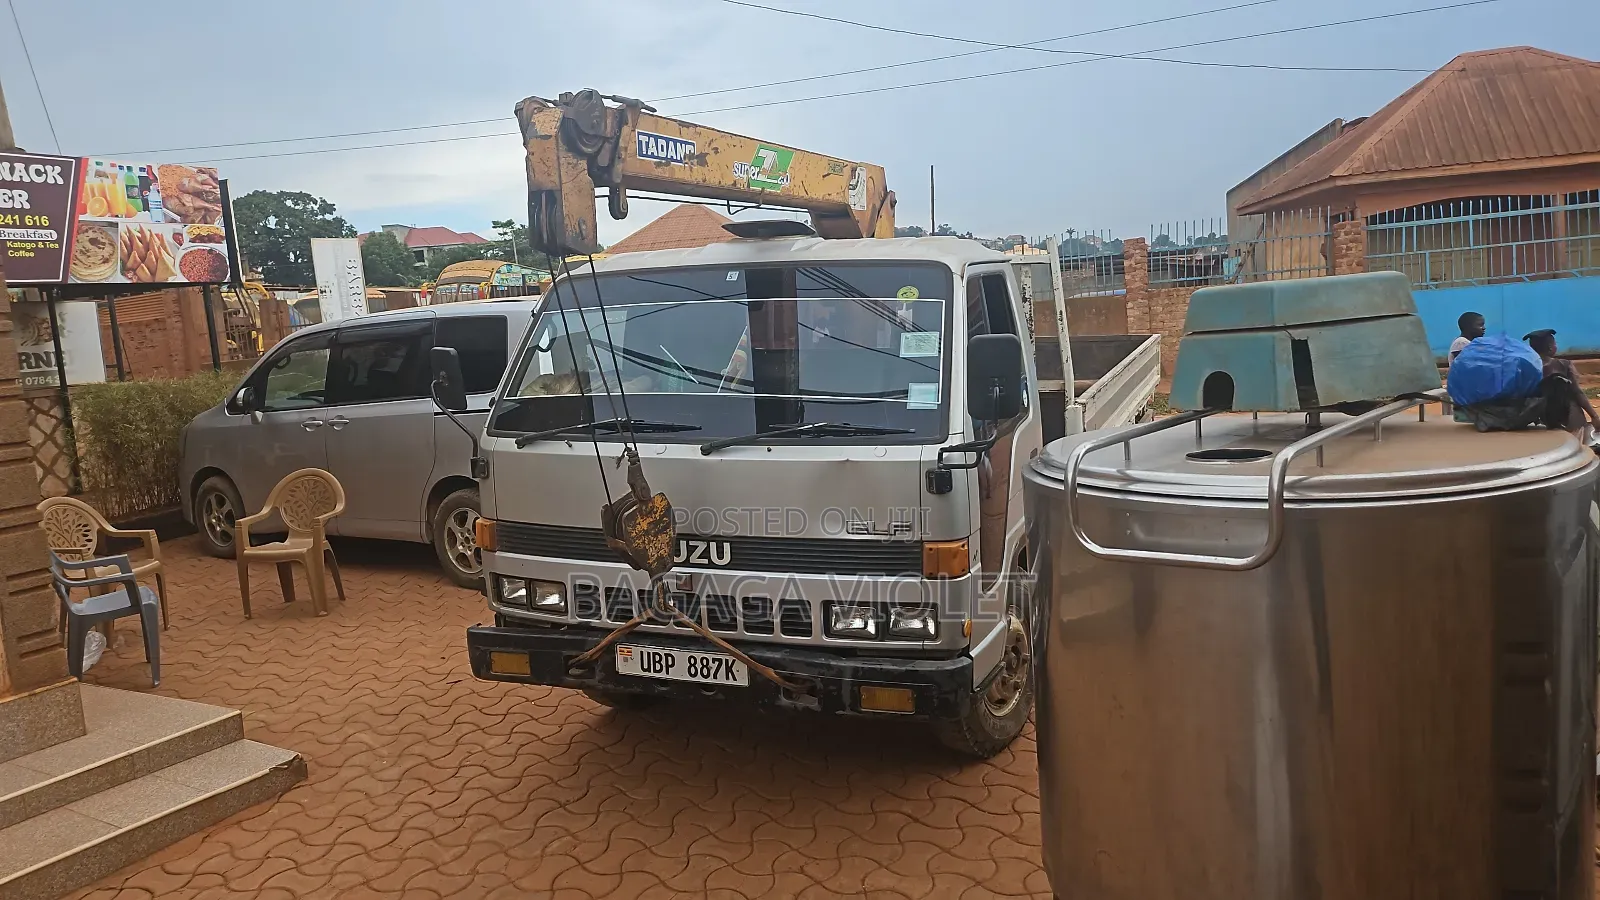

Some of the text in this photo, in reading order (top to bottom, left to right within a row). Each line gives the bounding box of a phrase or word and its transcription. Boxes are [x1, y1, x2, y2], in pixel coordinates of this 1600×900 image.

[0, 161, 64, 185] NACK
[25, 215, 50, 227] 616
[0, 229, 54, 240] Breakfast
[7, 241, 36, 250] Katogo
[45, 241, 59, 249] Tea
[8, 250, 35, 258] Coffee
[846, 520, 911, 536] ELF
[673, 540, 731, 566] UZU
[640, 650, 738, 682] UBP 887K
